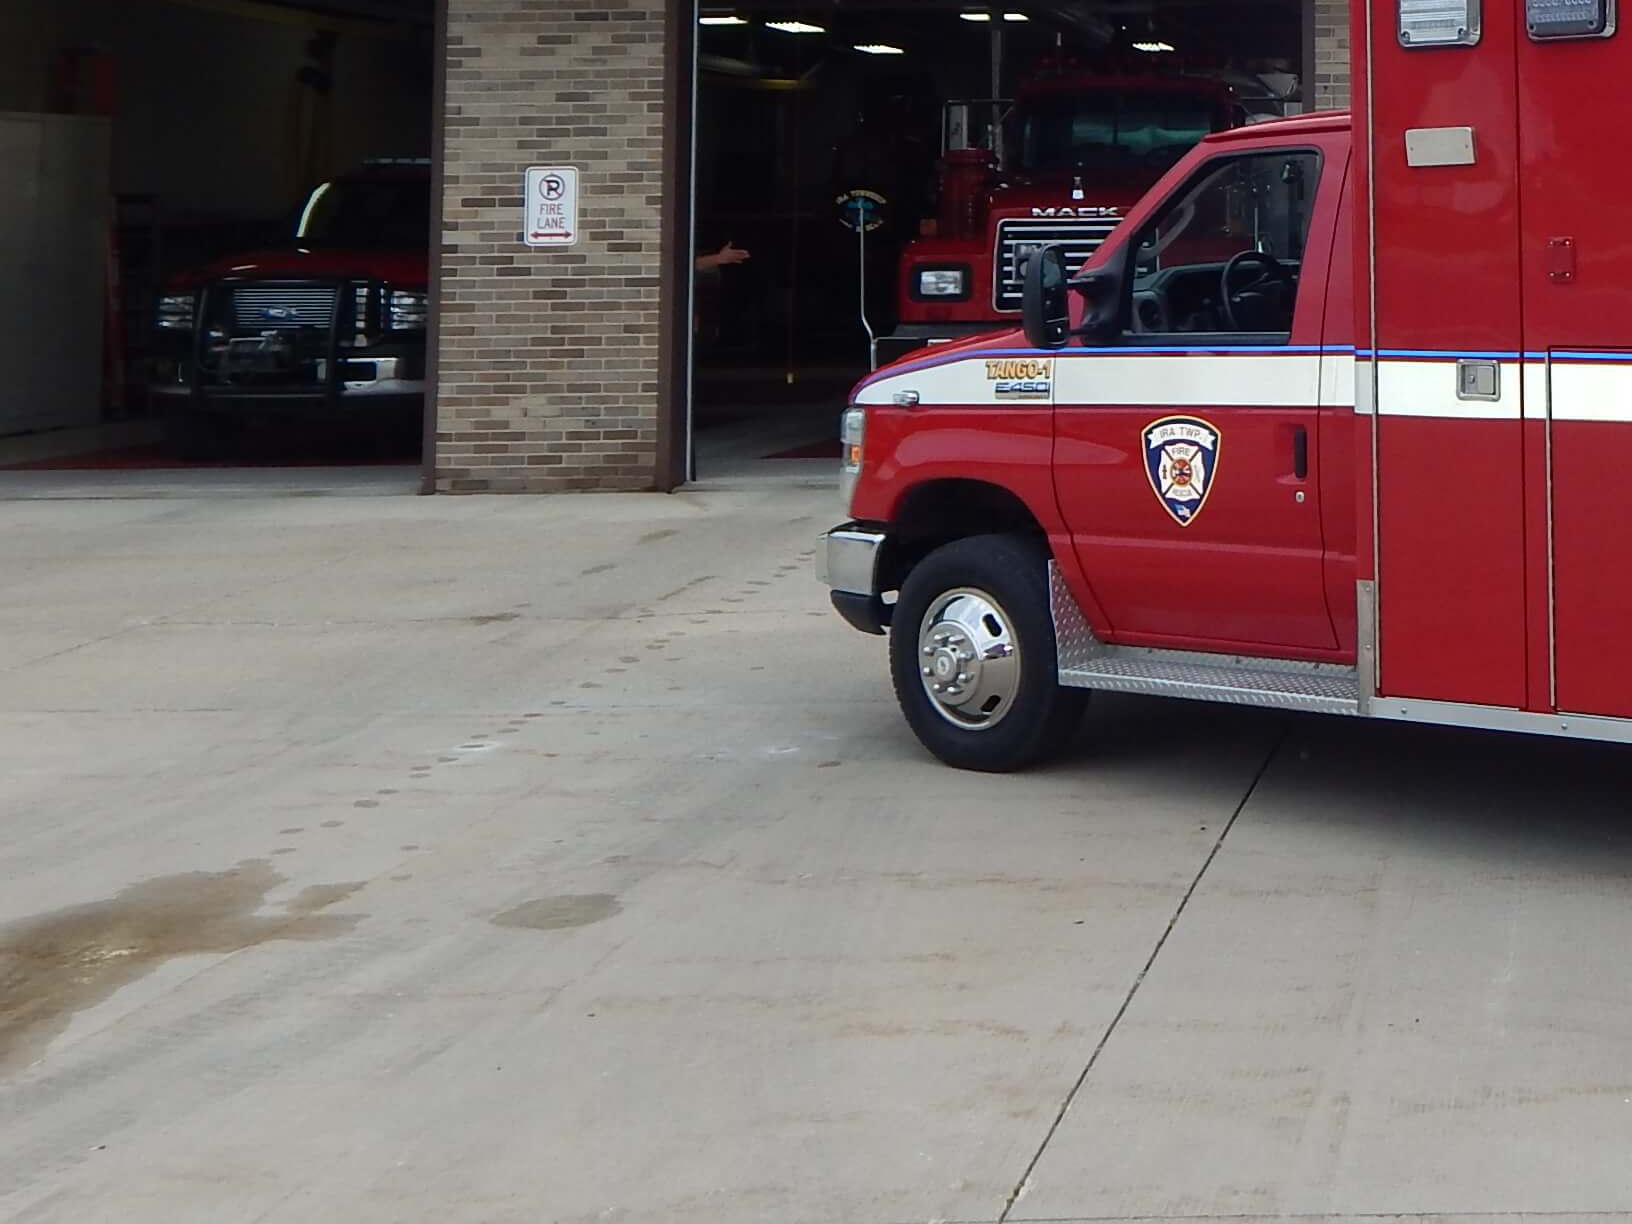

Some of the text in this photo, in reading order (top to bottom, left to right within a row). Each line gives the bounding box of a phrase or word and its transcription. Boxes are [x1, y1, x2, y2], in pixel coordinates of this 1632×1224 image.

[539, 203, 564, 215] FIRE
[1032, 207, 1119, 217] MACK
[537, 217, 566, 229] LANE
[985, 359, 1052, 380] TANGO-1
[995, 382, 1050, 393] E450
[1160, 428, 1176, 438] IRA
[1172, 447, 1191, 457] FIRE
